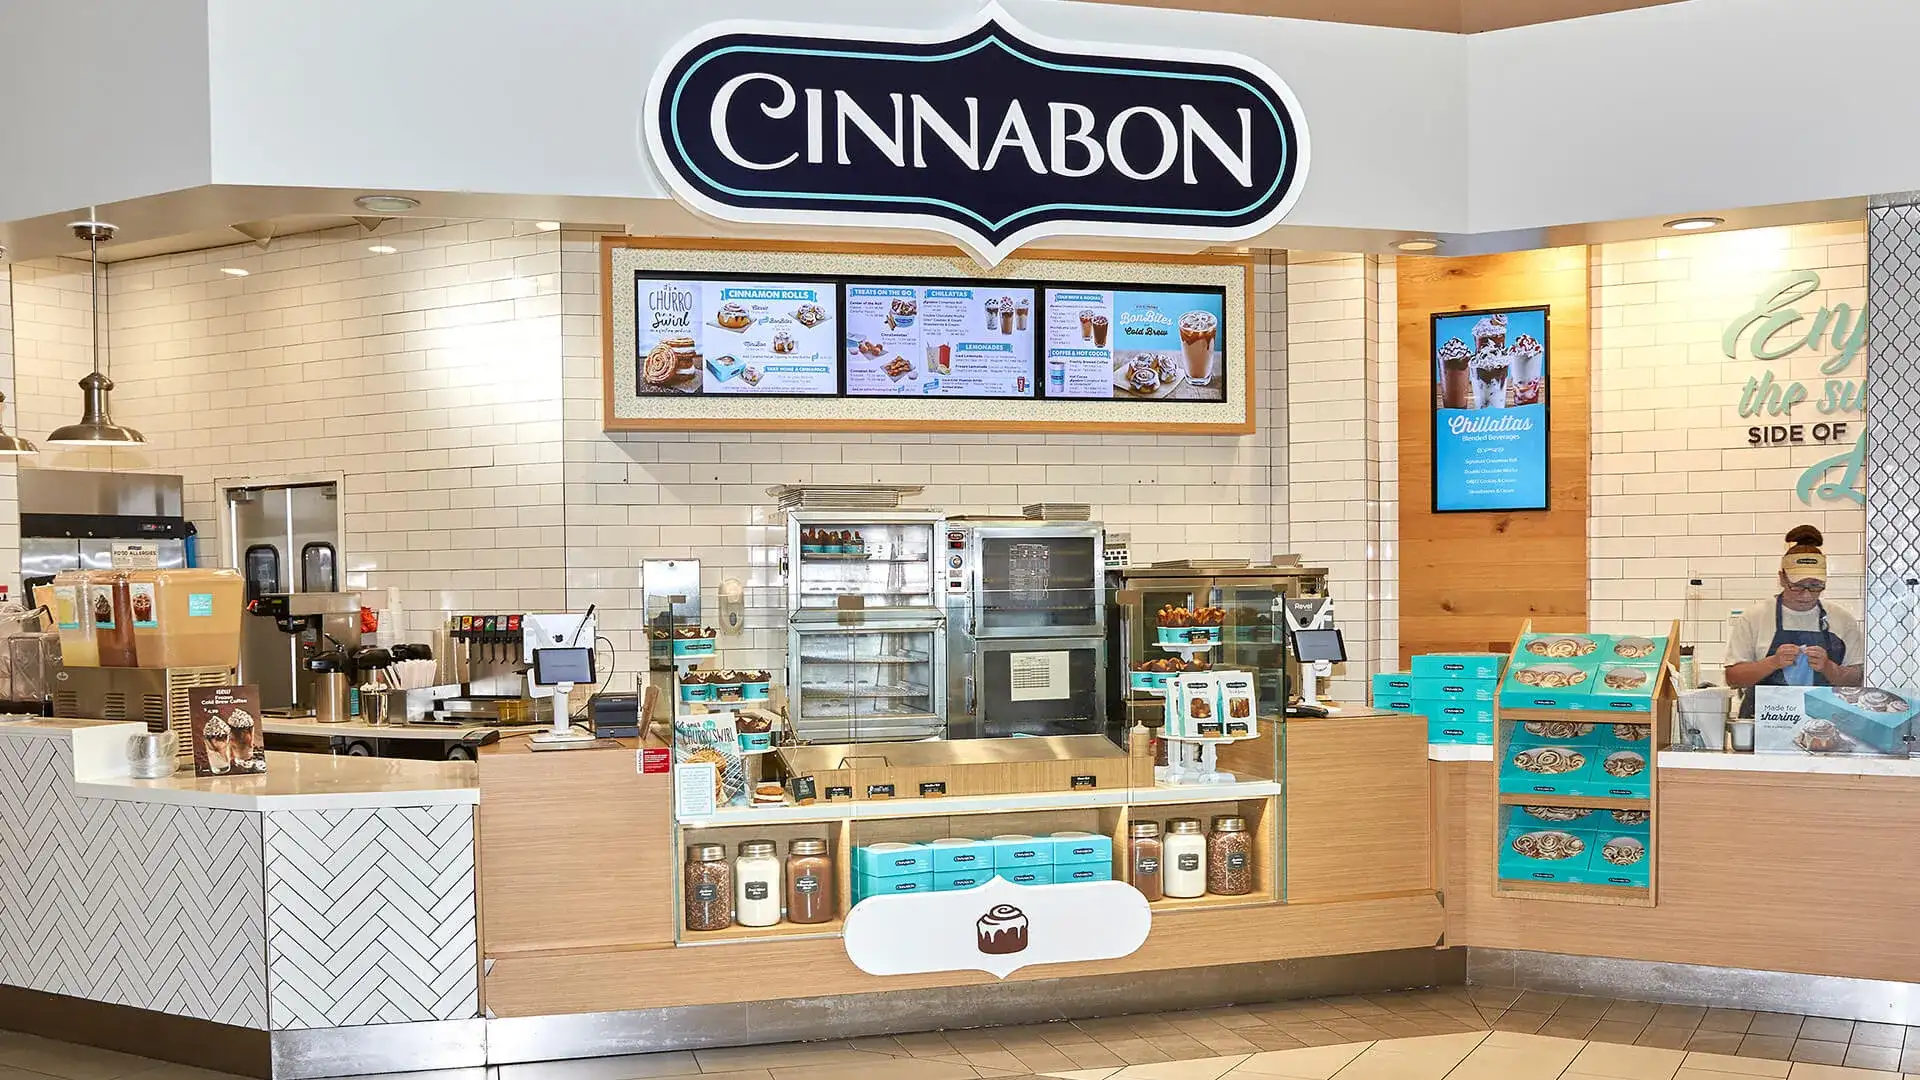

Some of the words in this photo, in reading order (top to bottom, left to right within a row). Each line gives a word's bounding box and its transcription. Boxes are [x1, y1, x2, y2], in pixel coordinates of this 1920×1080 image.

[710, 73, 1254, 188] CINNABON
[649, 290, 693, 311] CHURRO
[729, 290, 779, 298] CINNAMON
[781, 291, 809, 299] ROLLS
[652, 311, 690, 329] Swirl
[1120, 310, 1173, 326] BonBites
[1125, 327, 1145, 335] Cold
[1145, 327, 1168, 336] Brew
[1738, 370, 1808, 418] the
[1448, 415, 1533, 434] Chillattas
[1748, 425, 1804, 444] SIDE
[1812, 423, 1847, 441] OF
[1294, 602, 1313, 610] Revel
[1760, 711, 1802, 725] sharing
